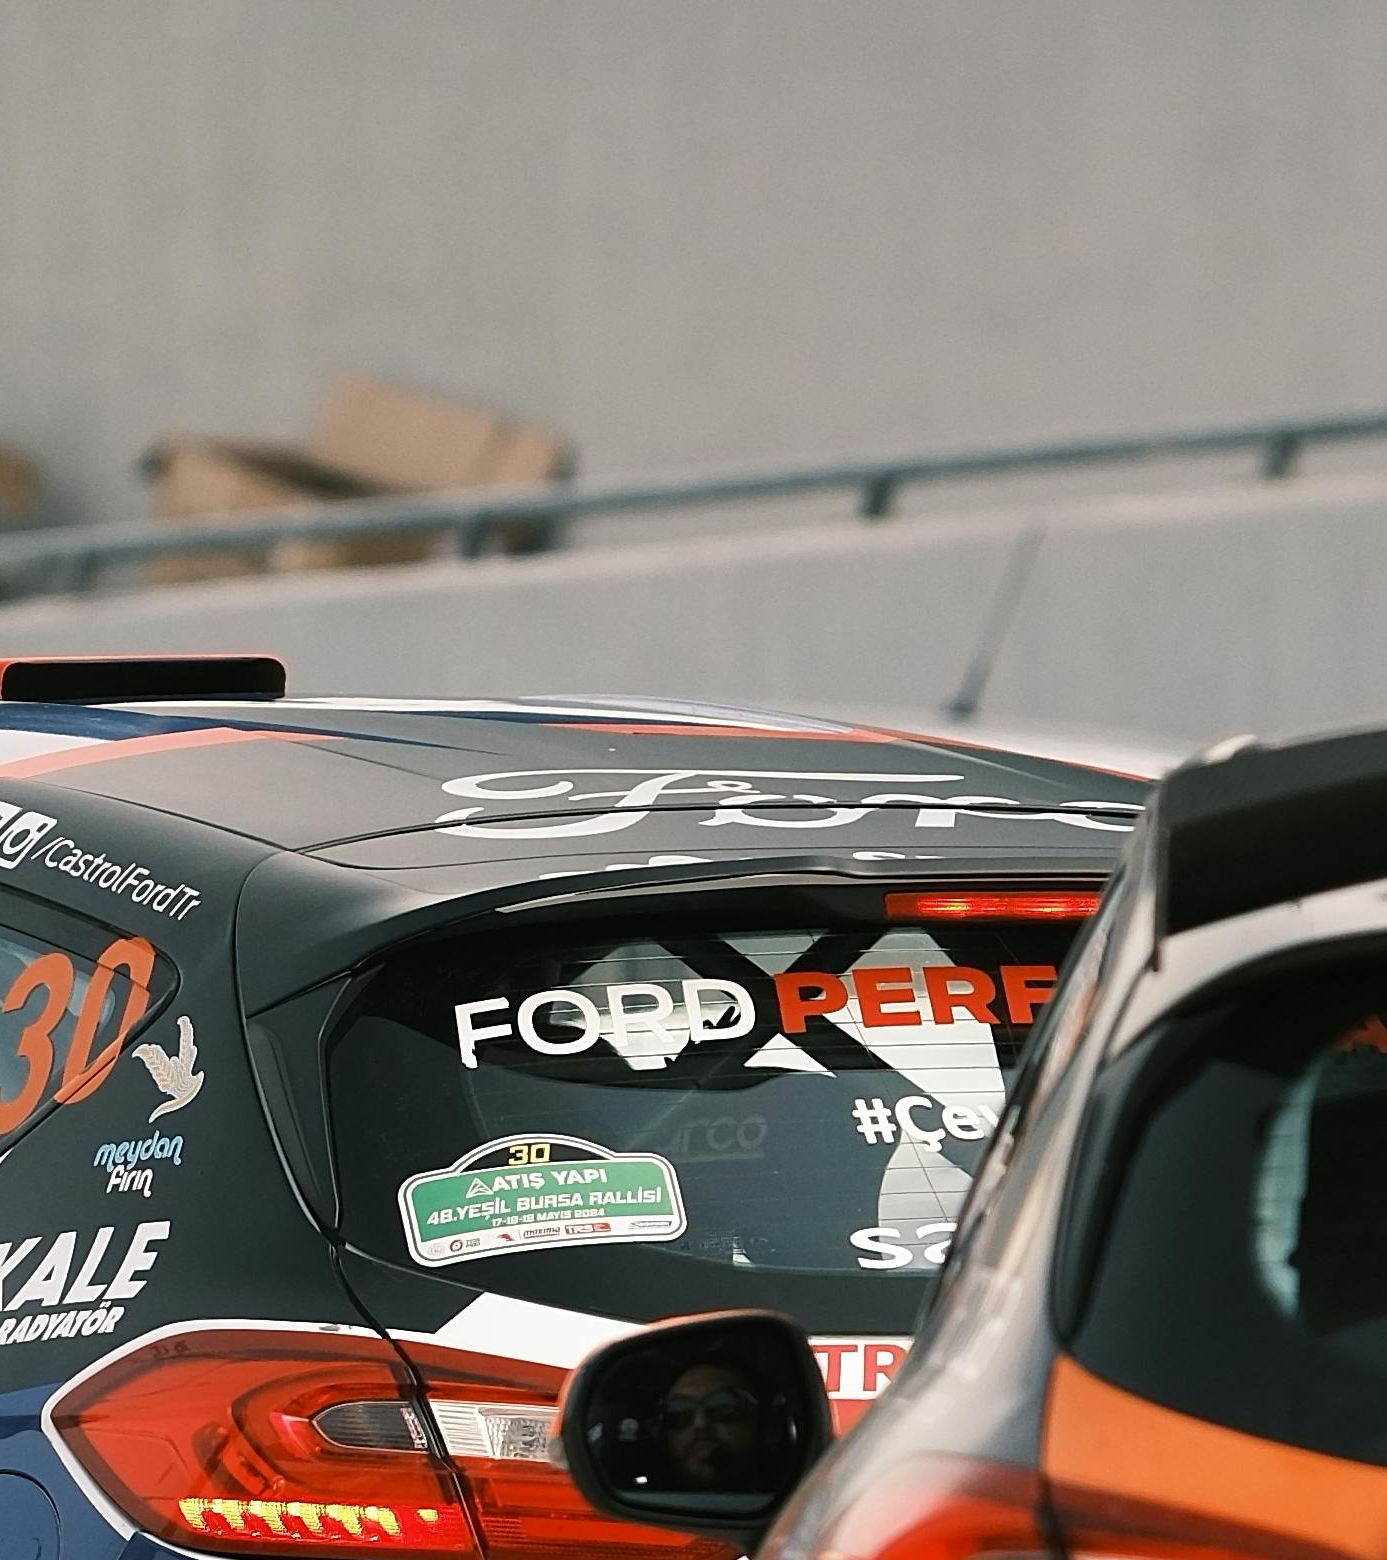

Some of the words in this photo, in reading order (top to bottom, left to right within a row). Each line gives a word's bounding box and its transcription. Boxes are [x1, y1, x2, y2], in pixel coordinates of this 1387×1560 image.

[454, 978, 756, 1070] FORD
[93, 1130, 184, 1172] meydan
[508, 1143, 552, 1166] 30
[491, 1172, 545, 1191] ATIŞ
[550, 1168, 607, 1187] YAPI
[517, 1191, 583, 1211] BURSA
